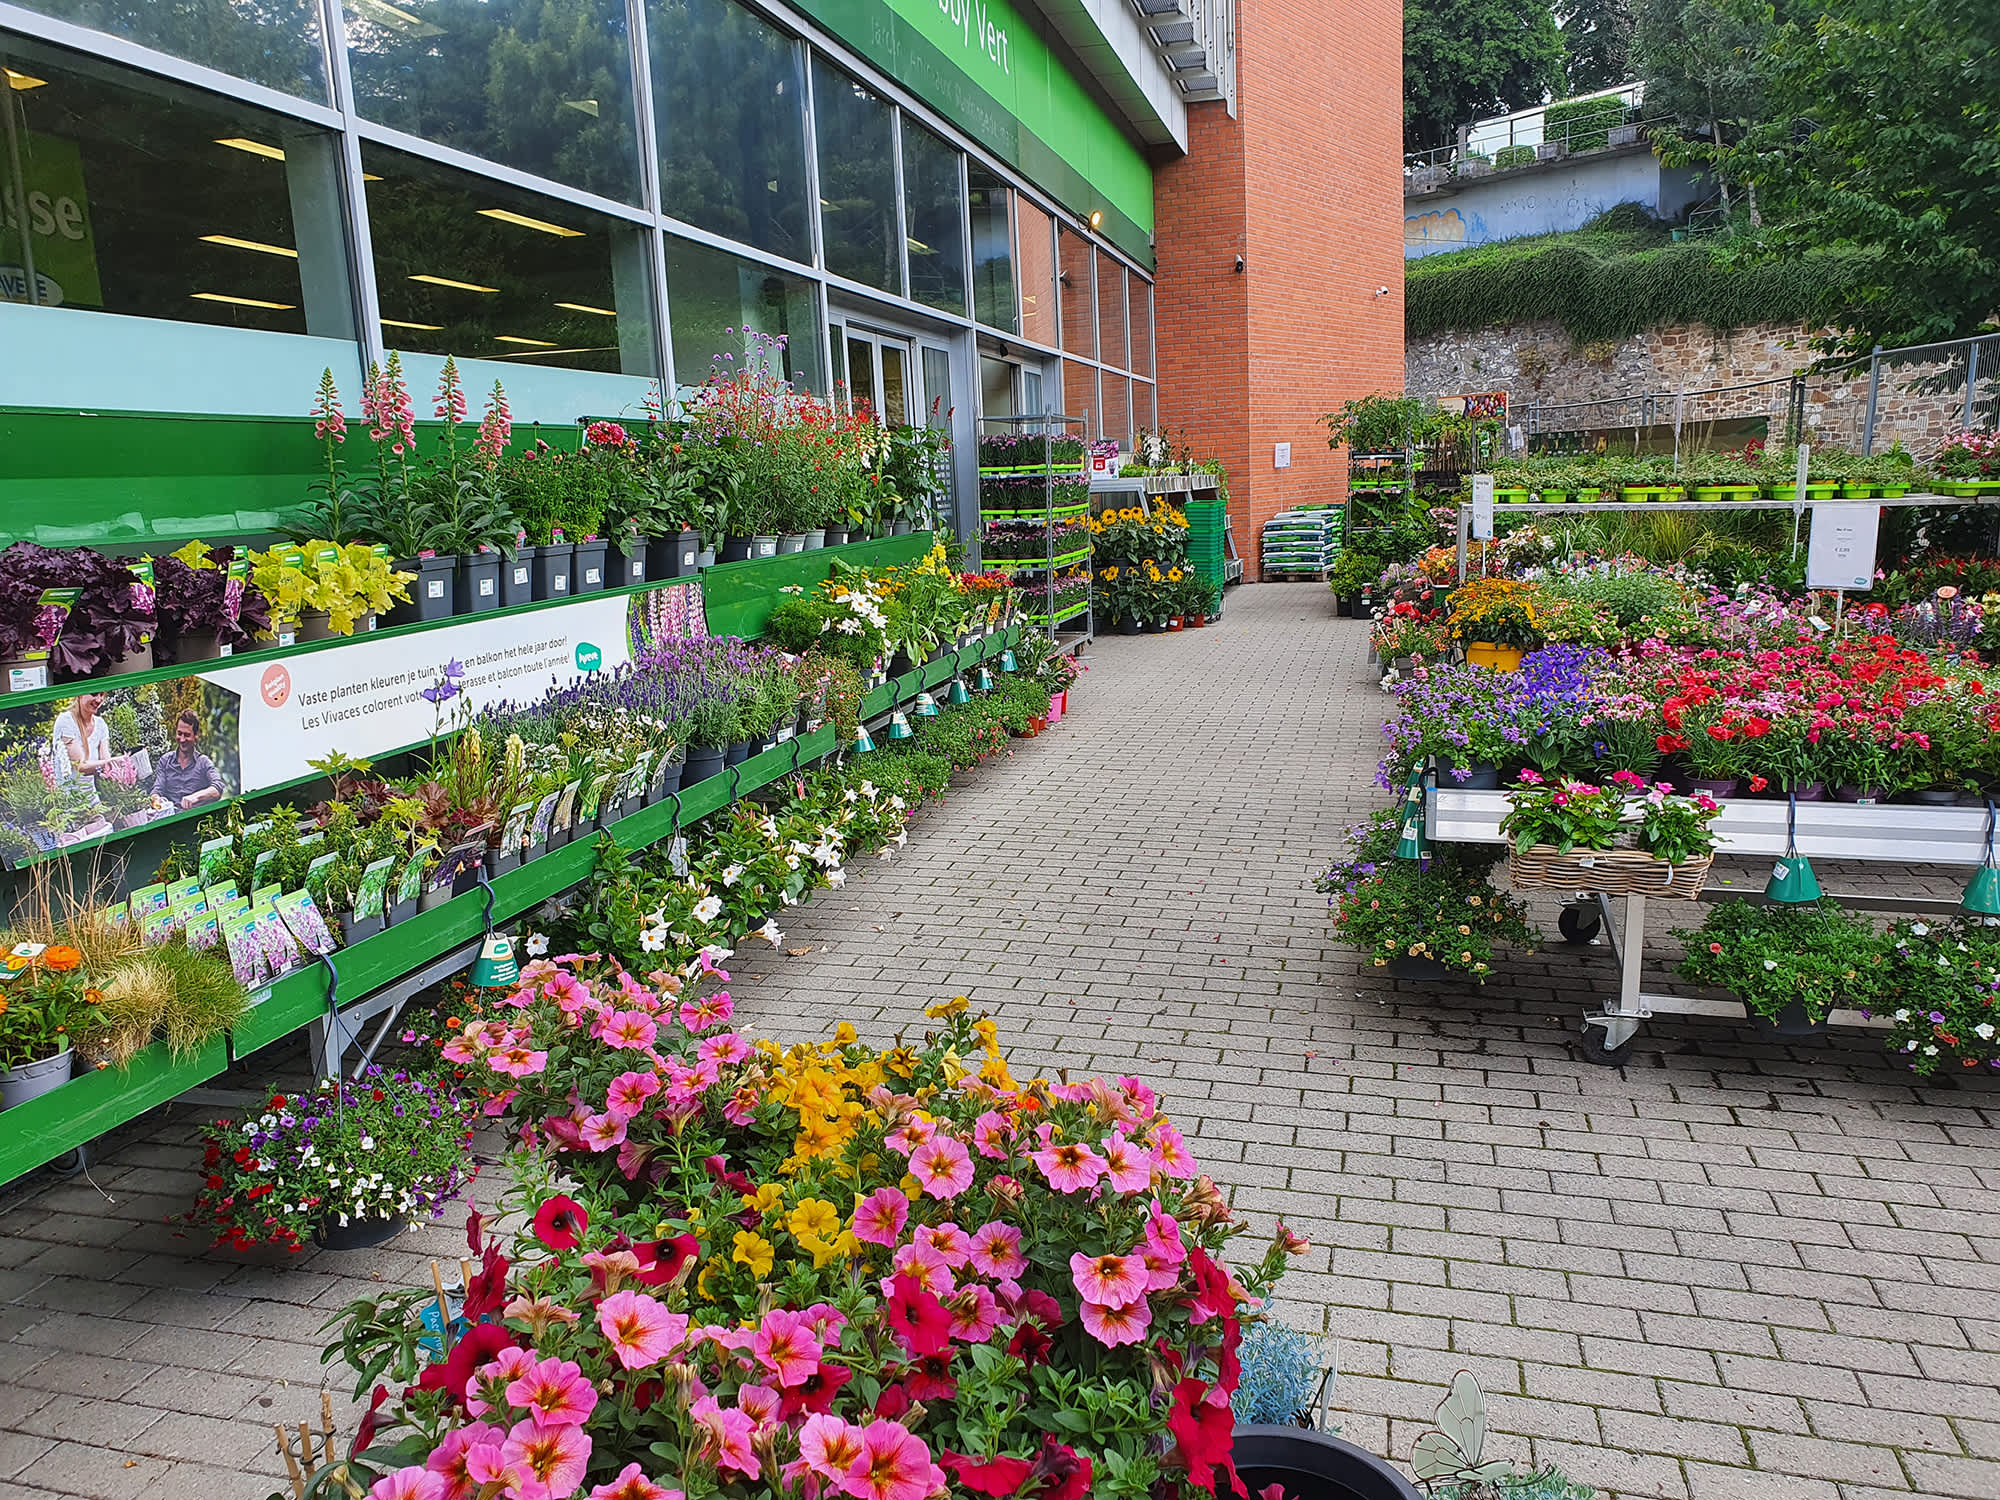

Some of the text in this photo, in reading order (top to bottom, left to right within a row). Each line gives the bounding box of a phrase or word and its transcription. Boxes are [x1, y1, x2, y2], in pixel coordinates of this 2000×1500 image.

[975, 0, 1009, 75] Vert
[0, 273, 48, 298] AVEE
[298, 690, 327, 706] Vaste
[330, 681, 369, 702] planten
[370, 674, 405, 691] kleuren
[406, 670, 416, 685] je
[465, 659, 475, 668] en
[476, 652, 503, 666] balkon
[504, 647, 516, 659] het
[517, 643, 533, 656] hele
[534, 641, 547, 655] jaar
[548, 636, 568, 649] door!
[302, 716, 320, 730] Les
[321, 707, 361, 725] Vivaces
[362, 696, 403, 715] colorent
[404, 689, 423, 703] votr
[488, 672, 496, 682] et
[497, 666, 523, 681] balcon
[523, 660, 543, 673] toute
